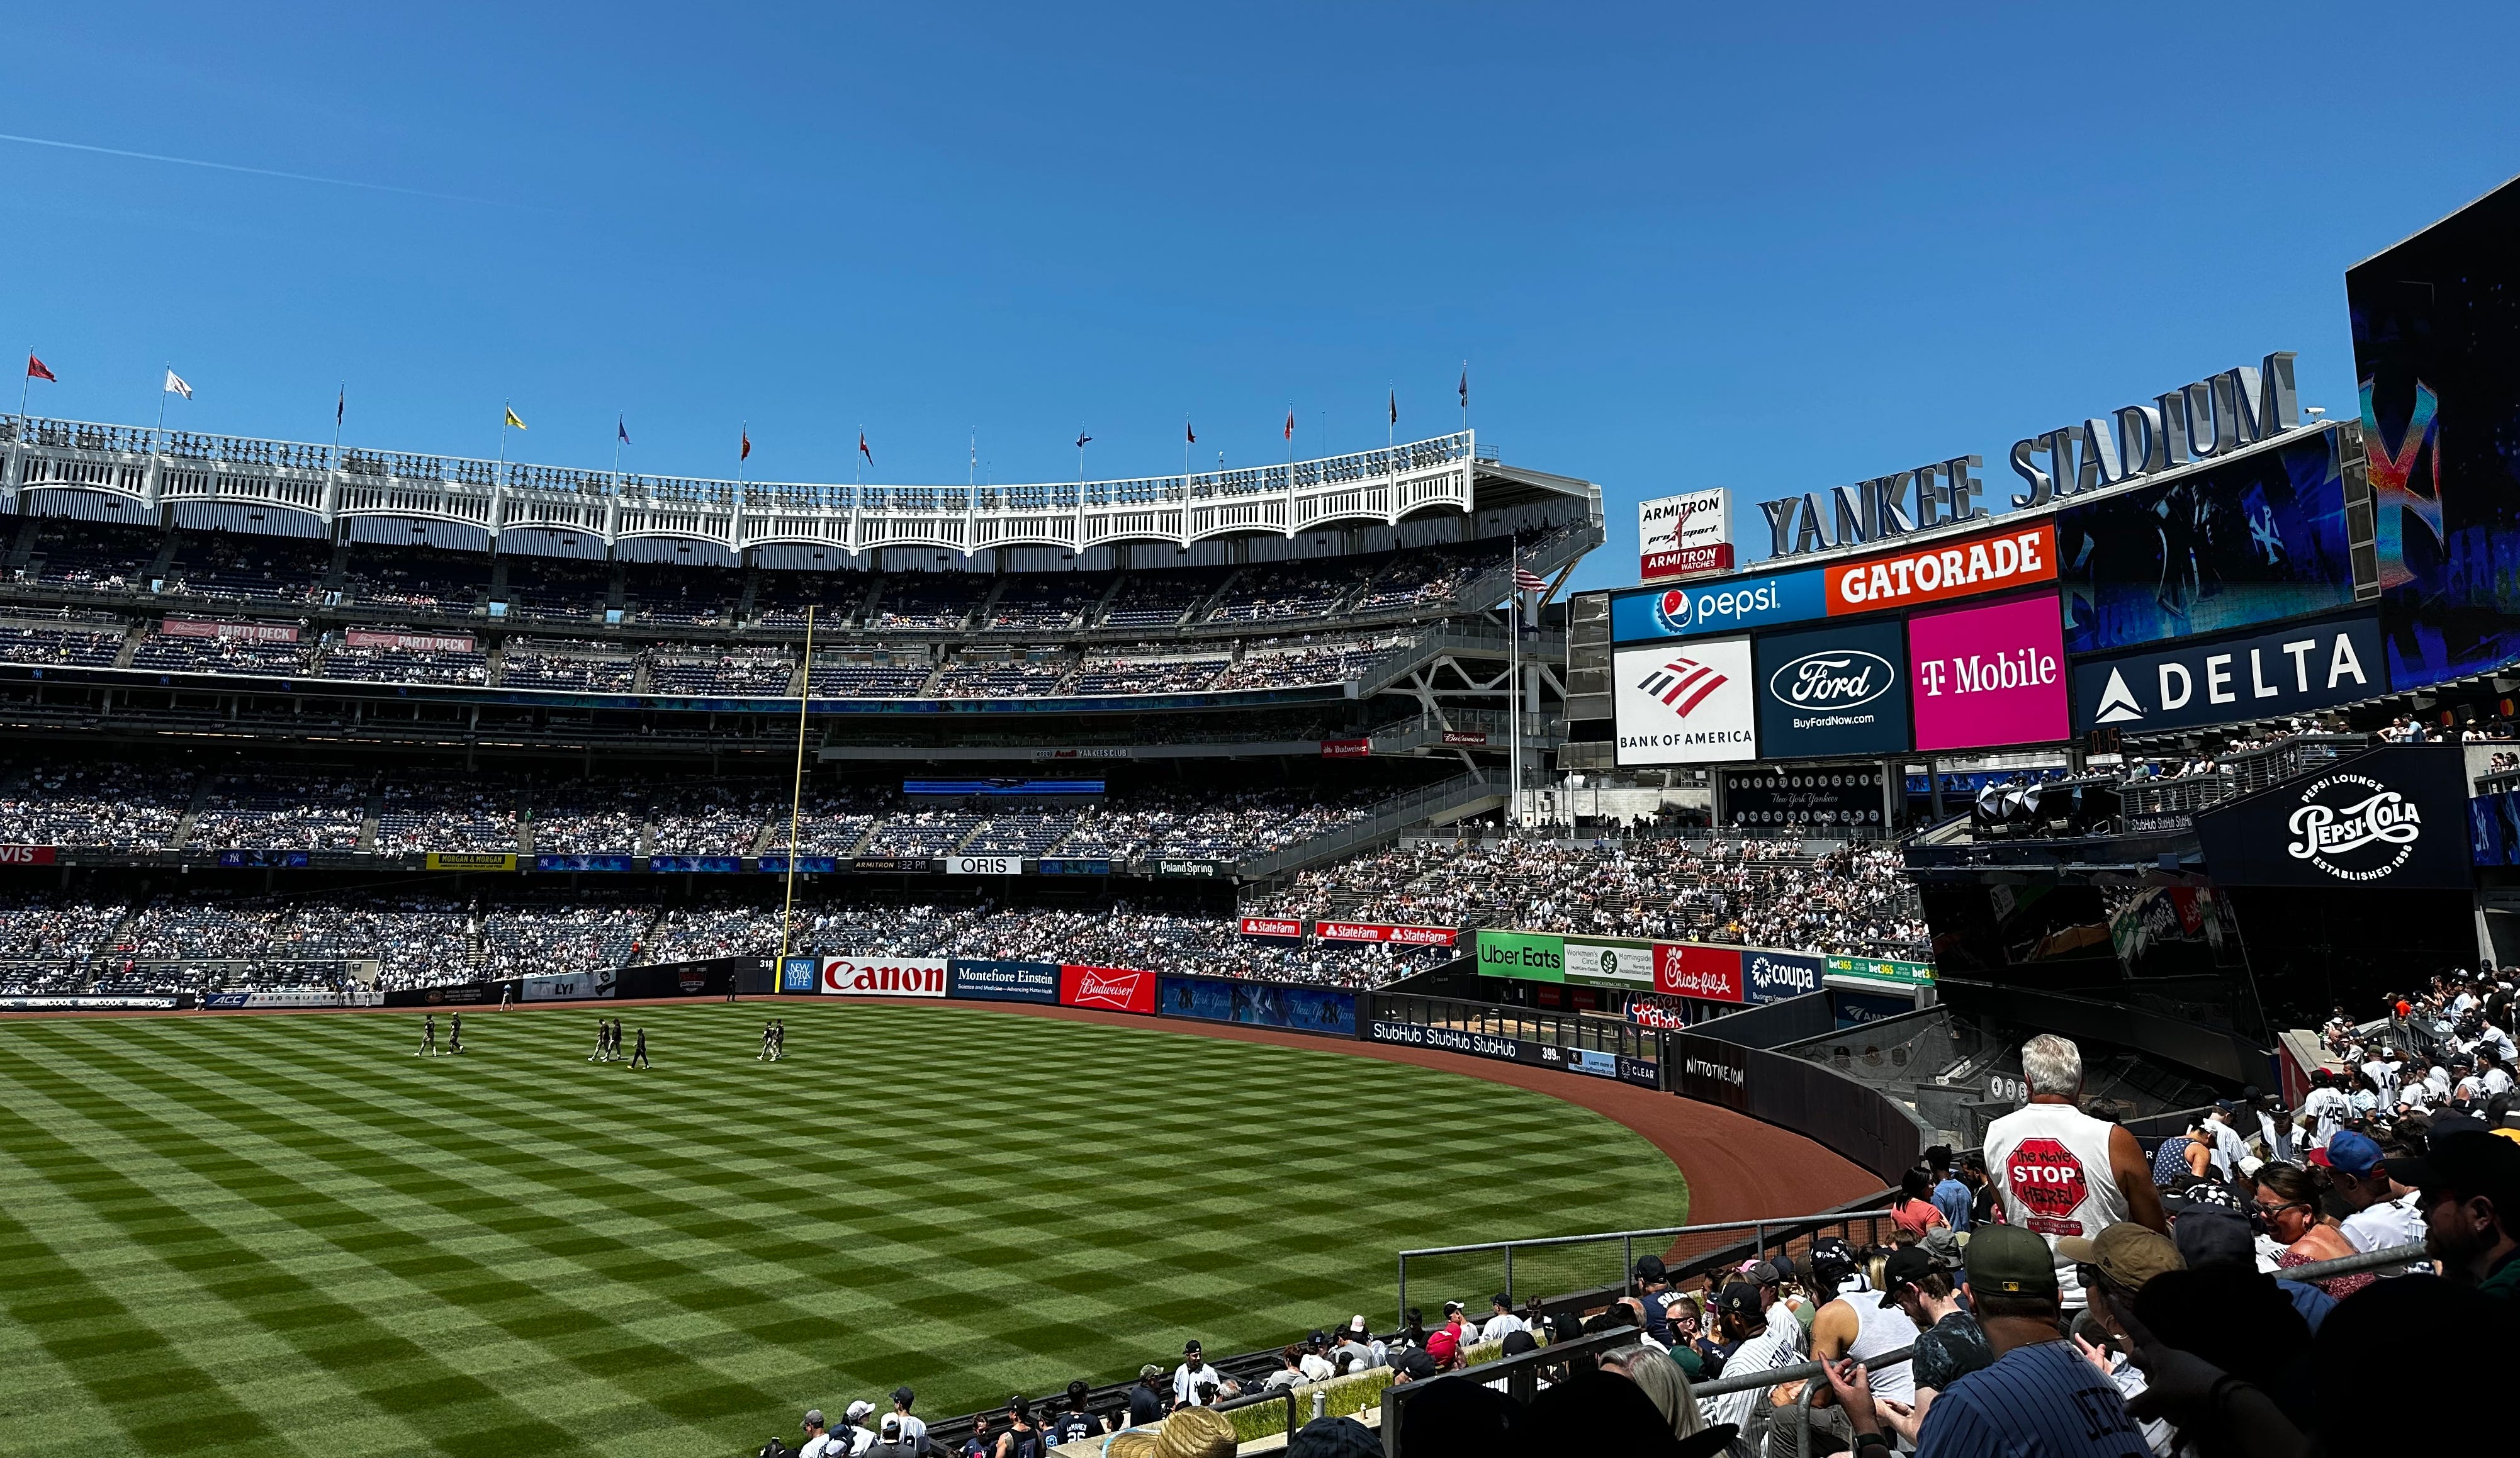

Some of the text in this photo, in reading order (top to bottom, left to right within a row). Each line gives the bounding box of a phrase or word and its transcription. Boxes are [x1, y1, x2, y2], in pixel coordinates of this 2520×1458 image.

[1756, 350, 2299, 559] YANKEE STADIUM
[1643, 497, 1719, 522] ARMITRON
[1648, 548, 1717, 568] ARMITRON
[1681, 559, 1716, 570] WATCHES
[1840, 532, 2042, 604] GATORADE
[1699, 581, 1778, 624] pepsi
[218, 624, 257, 637] PARTY
[259, 627, 290, 639] DECK
[398, 636, 434, 648] PARTY
[436, 639, 466, 650] DECK
[2159, 632, 2367, 711] DELTA
[1792, 658, 1871, 702] Ford
[1793, 714, 1874, 730] BuyFordNow.com
[1620, 730, 1753, 748] BANK OF AMERICA
[1079, 749, 1108, 758] YANKEES
[1110, 749, 1127, 757] CLUB
[1335, 745, 1366, 753] Budweiser
[2301, 774, 2385, 803] PEPSI LOUNGE
[1789, 793, 1806, 807] York
[476, 855, 502, 863] MORGAN
[2392, 844, 2412, 868] 1898
[898, 861, 913, 870] 1:32
[915, 861, 926, 870] PM
[961, 858, 1007, 873] ORIS
[1161, 861, 1213, 876] Poland Spring
[2312, 856, 2392, 880] ESTABLISHED
[1482, 944, 1560, 969] Uber Eats
[1567, 949, 1598, 958] Workmen's
[760, 960, 773, 968] 318
[790, 963, 810, 972] NEW
[1828, 958, 1852, 971] bet365
[1869, 962, 1894, 975] bet365
[787, 970, 811, 980] YORK
[825, 961, 943, 992] Canon
[958, 968, 1053, 984] Montefiore Einstein
[1665, 954, 1731, 994] Chick-fil-A
[1772, 964, 1814, 994] coupa
[789, 979, 807, 987] LIFE
[1081, 978, 1132, 995] Budweiser
[1632, 992, 1684, 1018] Jersey
[1373, 1023, 1516, 1057] StubHub StubHub StubHub
[1633, 1066, 1654, 1080] CLEAR
[1994, 1082, 1998, 1092] 4
[2008, 1084, 2012, 1095] 3
[2020, 1087, 2025, 1098] 5
[2326, 1107, 2343, 1125] 45
[2015, 1150, 2036, 1163] The
